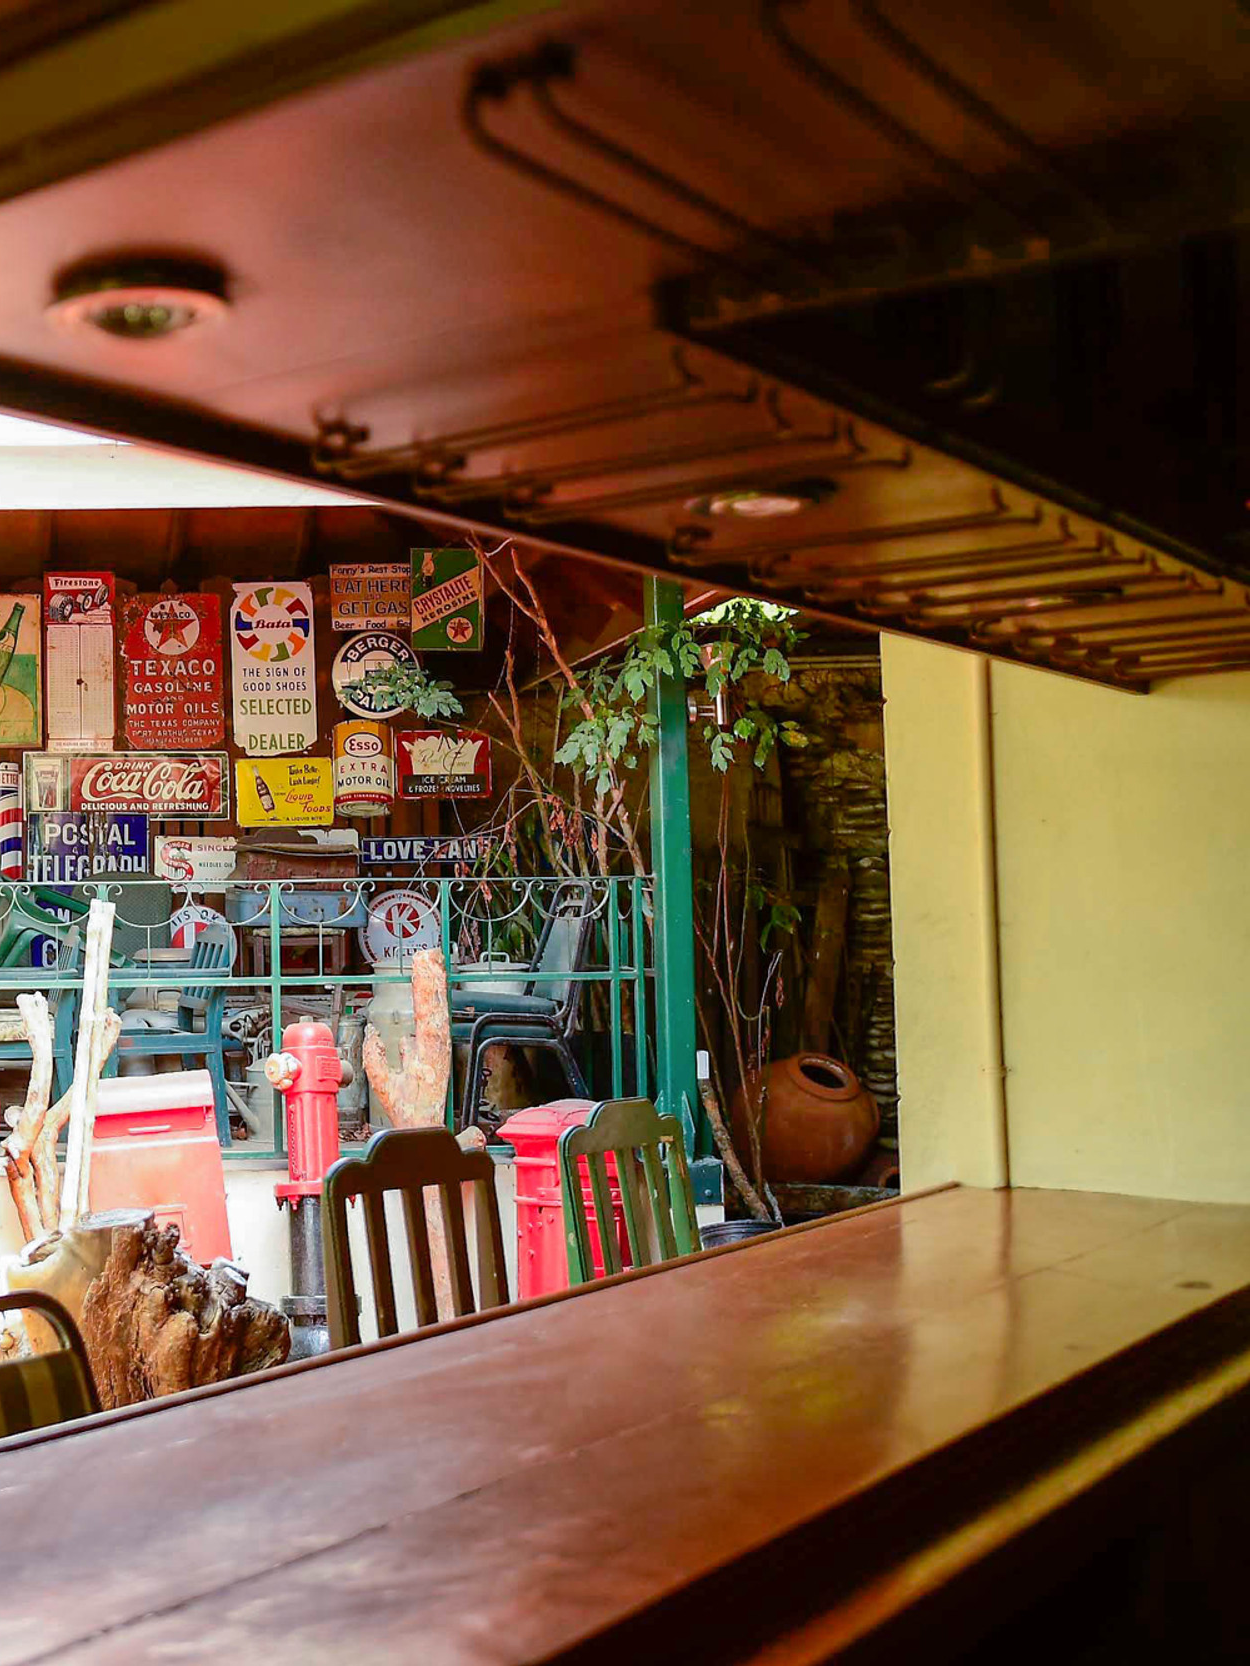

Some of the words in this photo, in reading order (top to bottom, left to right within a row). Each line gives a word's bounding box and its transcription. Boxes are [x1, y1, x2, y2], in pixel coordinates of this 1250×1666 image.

[53, 578, 100, 587] Firestone
[335, 580, 362, 593] EAT
[414, 575, 473, 615] CRYSTALITE
[339, 601, 371, 614] GET
[375, 601, 408, 614] GAS
[421, 590, 478, 623] KEROSINE
[254, 619, 291, 629] Bata
[334, 621, 355, 630] Beer
[366, 620, 387, 629] Food
[347, 637, 409, 661] BERGER
[130, 660, 215, 676] TEXACO
[242, 668, 260, 677] THE
[266, 667, 289, 677] SIGN
[294, 667, 306, 676] OF
[134, 682, 213, 693] GASOLINE
[243, 682, 271, 692] GOOD
[276, 682, 306, 692] SHOES
[127, 703, 174, 714] MOTOR
[184, 703, 219, 714] OILS
[240, 698, 312, 716] SELECTED
[151, 720, 177, 728] TEXAS
[182, 719, 220, 727] COMPANY
[249, 733, 305, 750] DEALER
[349, 738, 378, 751] Esso
[114, 762, 152, 770] DRINK
[340, 762, 387, 773] EXTRA
[81, 762, 208, 802] Coca-Cola
[338, 776, 372, 788] MOTOR
[375, 777, 390, 789] OIL
[445, 784, 480, 792] NOVELTIES
[81, 803, 127, 811] DELICIOUS
[130, 803, 149, 811] AND
[152, 802, 209, 811] REFRESHING
[45, 823, 136, 846] POSTAL
[370, 841, 425, 860] LOVE
[383, 943, 427, 958] KEL'S
